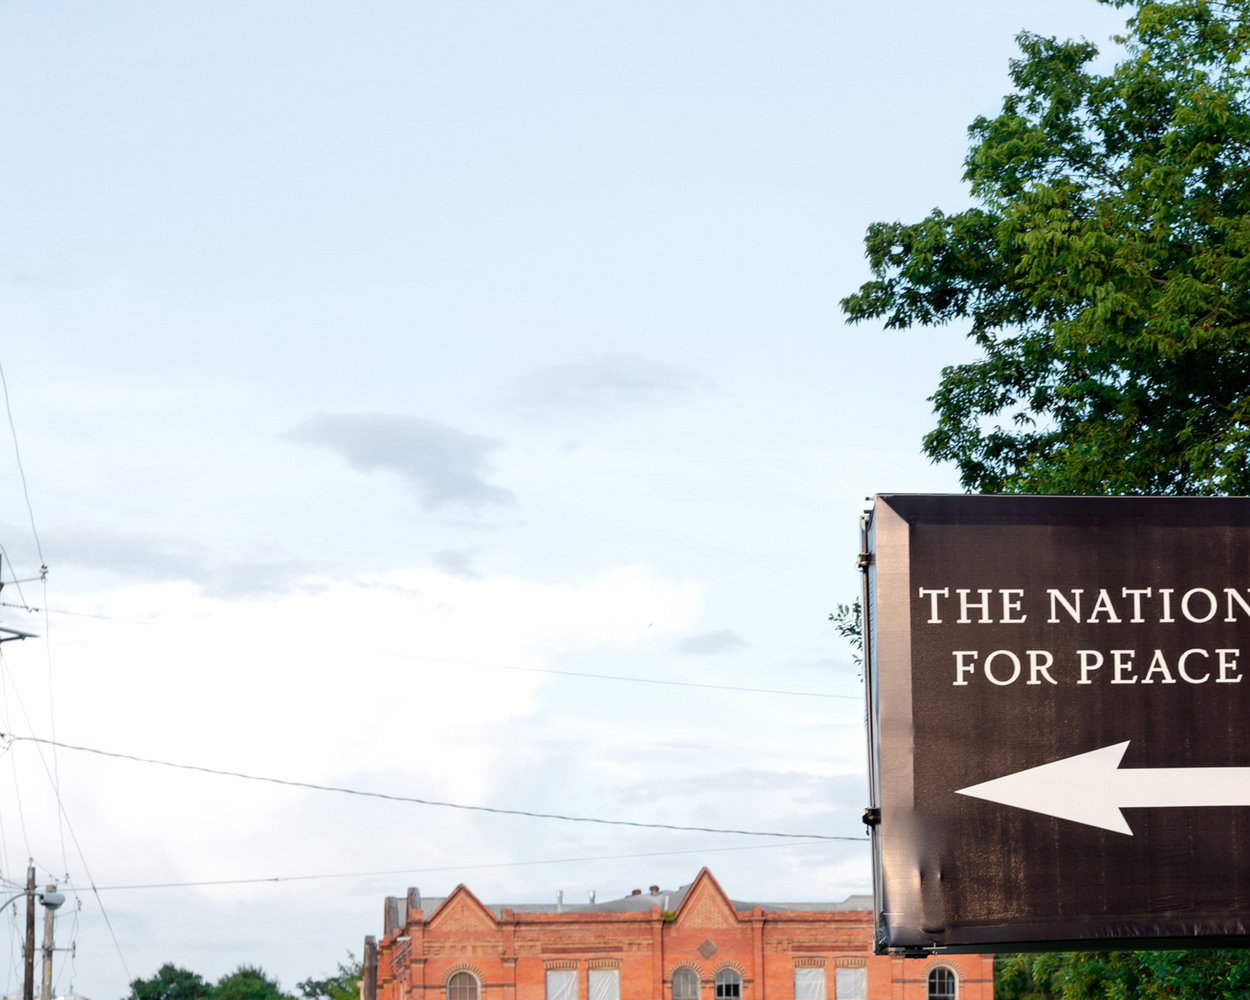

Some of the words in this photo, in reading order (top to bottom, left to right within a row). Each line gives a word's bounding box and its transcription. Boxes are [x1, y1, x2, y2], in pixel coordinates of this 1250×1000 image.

[918, 586, 1028, 624] THE
[951, 648, 1058, 686] FOR
[1075, 648, 1242, 685] PEACE
